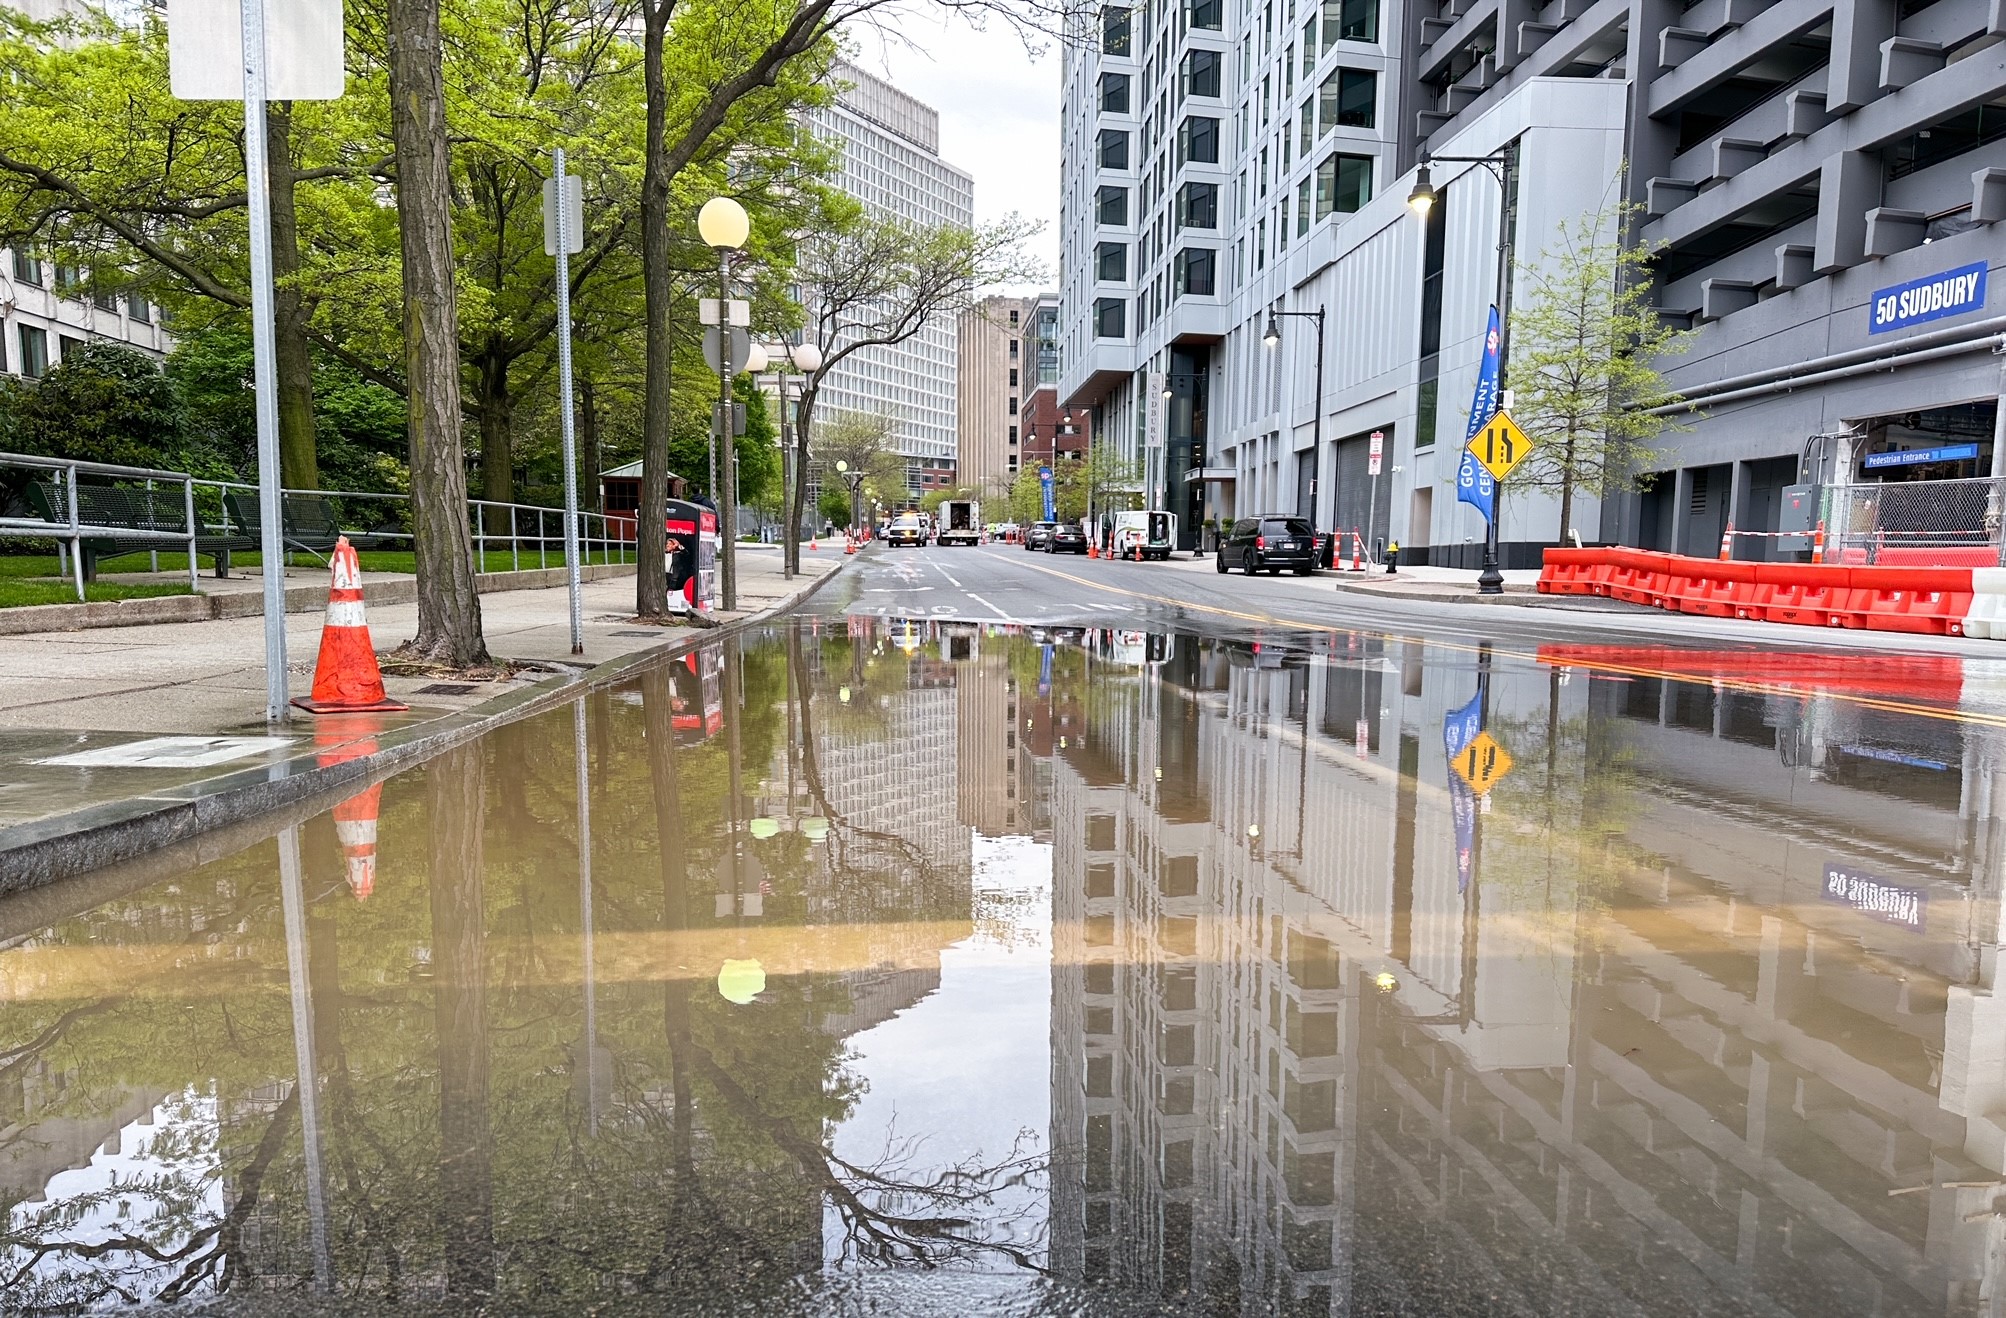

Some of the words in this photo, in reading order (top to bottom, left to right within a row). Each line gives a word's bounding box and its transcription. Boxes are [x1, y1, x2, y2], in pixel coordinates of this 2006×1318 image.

[1876, 295, 1897, 325] 50
[1898, 271, 1979, 319] SUDBURY
[1482, 371, 1498, 427] ARAGE
[1461, 378, 1489, 487] GOVENMENT
[1869, 455, 1901, 465] Pedestrian
[1902, 452, 1930, 462] Entrance
